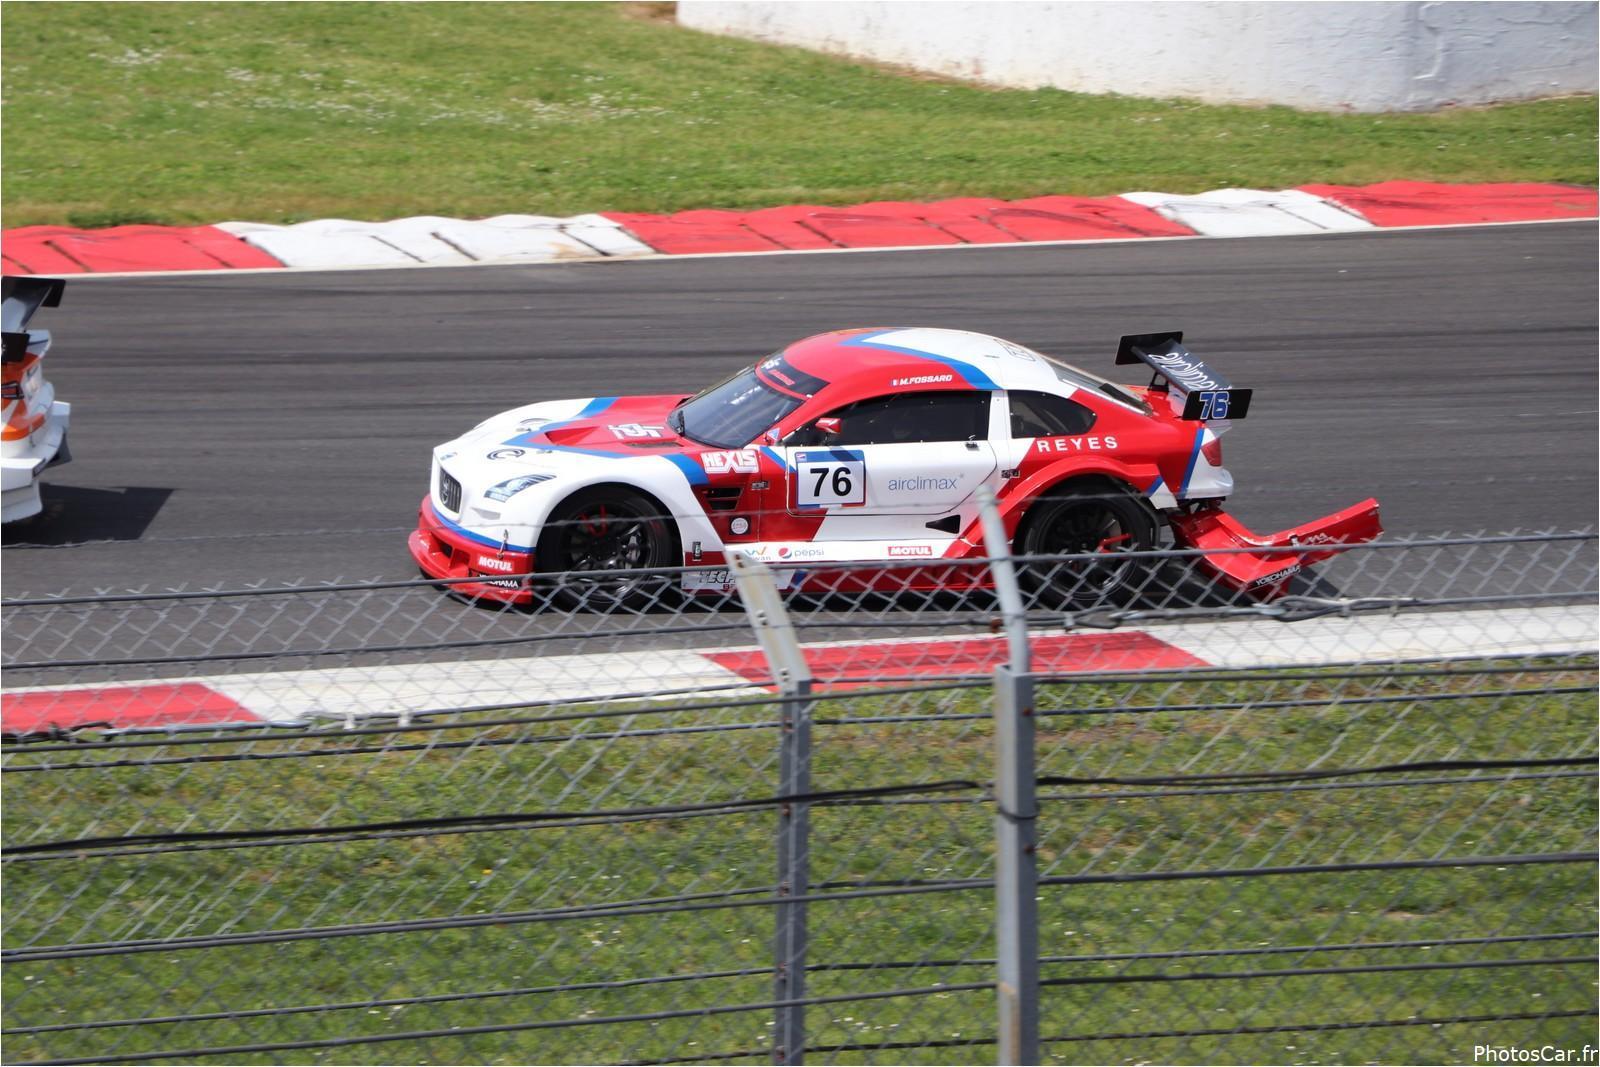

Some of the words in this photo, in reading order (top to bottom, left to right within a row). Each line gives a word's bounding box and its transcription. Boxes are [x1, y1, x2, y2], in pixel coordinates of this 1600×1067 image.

[1147, 352, 1231, 391] airclima
[1199, 391, 1229, 420] 76
[1036, 436, 1118, 453] REYES
[701, 450, 759, 473] HEXIS
[809, 466, 852, 497] 76
[887, 474, 957, 491] airclimax
[794, 548, 825, 558] pepsi
[889, 546, 932, 556] MOTUL
[478, 556, 513, 571] MOTUL
[1256, 565, 1301, 586] YOKOHAMA
